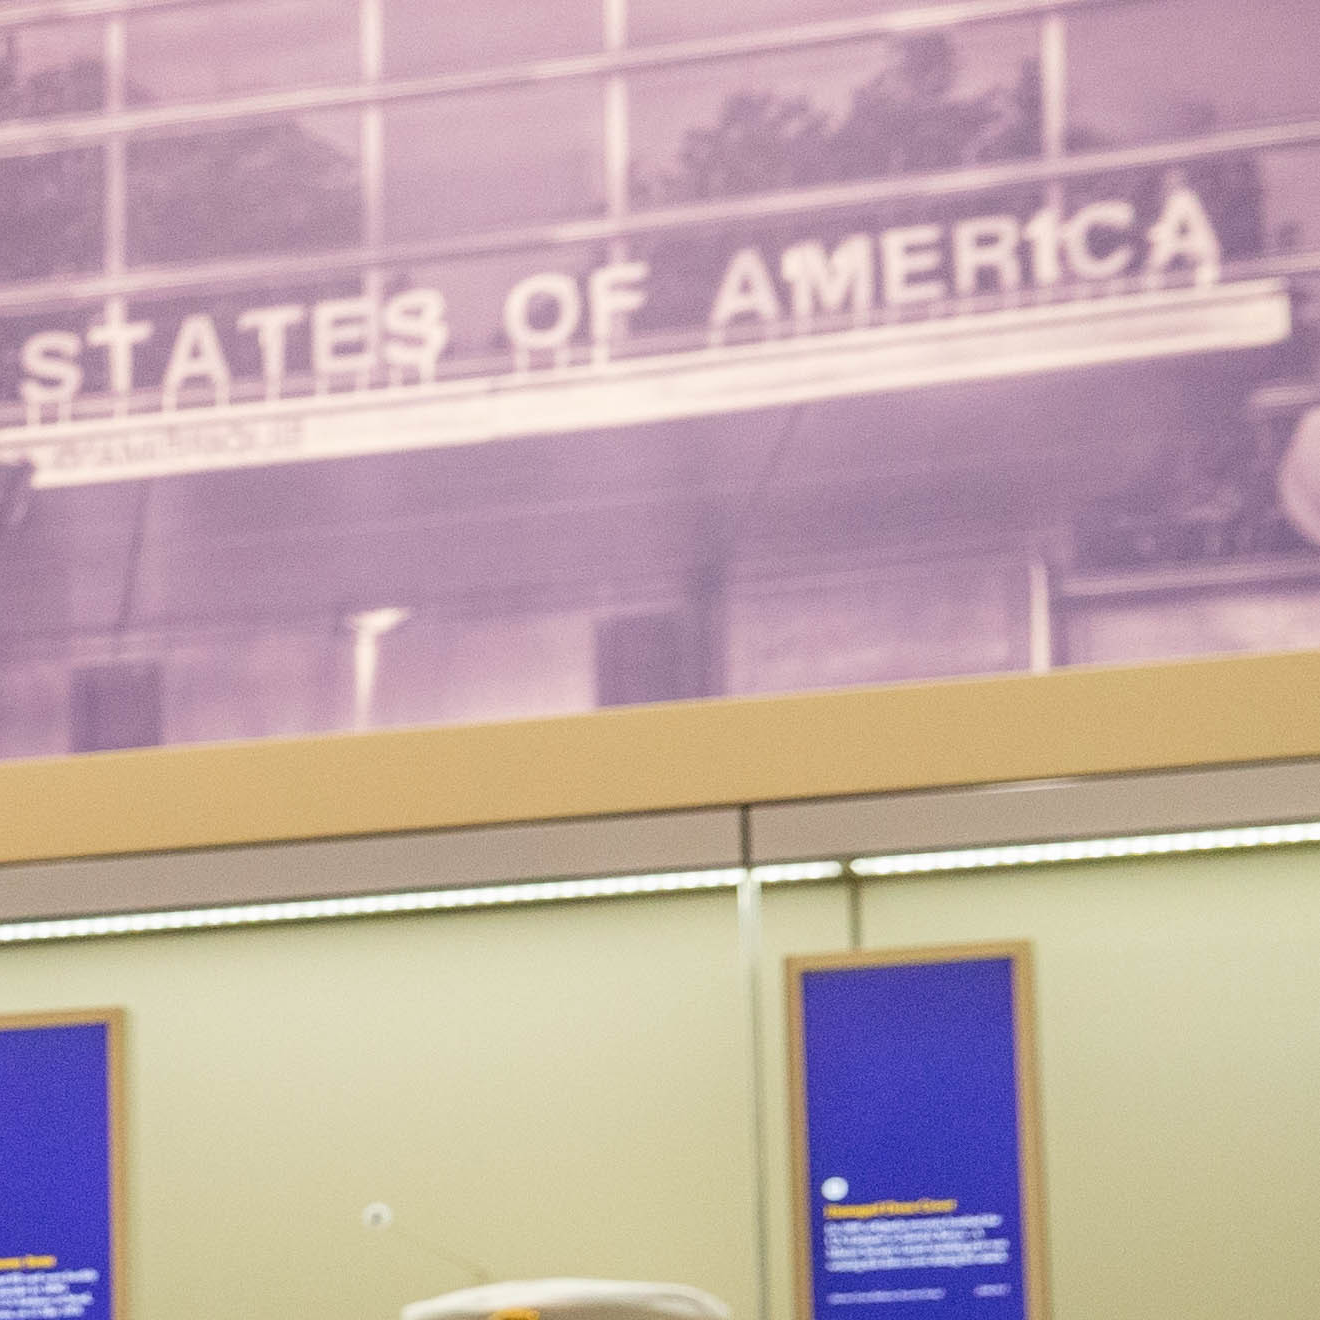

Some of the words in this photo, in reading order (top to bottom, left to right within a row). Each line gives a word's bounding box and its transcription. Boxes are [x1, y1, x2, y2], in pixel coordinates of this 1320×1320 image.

[18, 286, 447, 402] STATES
[503, 261, 651, 350] OF
[715, 183, 1222, 324] AMERICA
